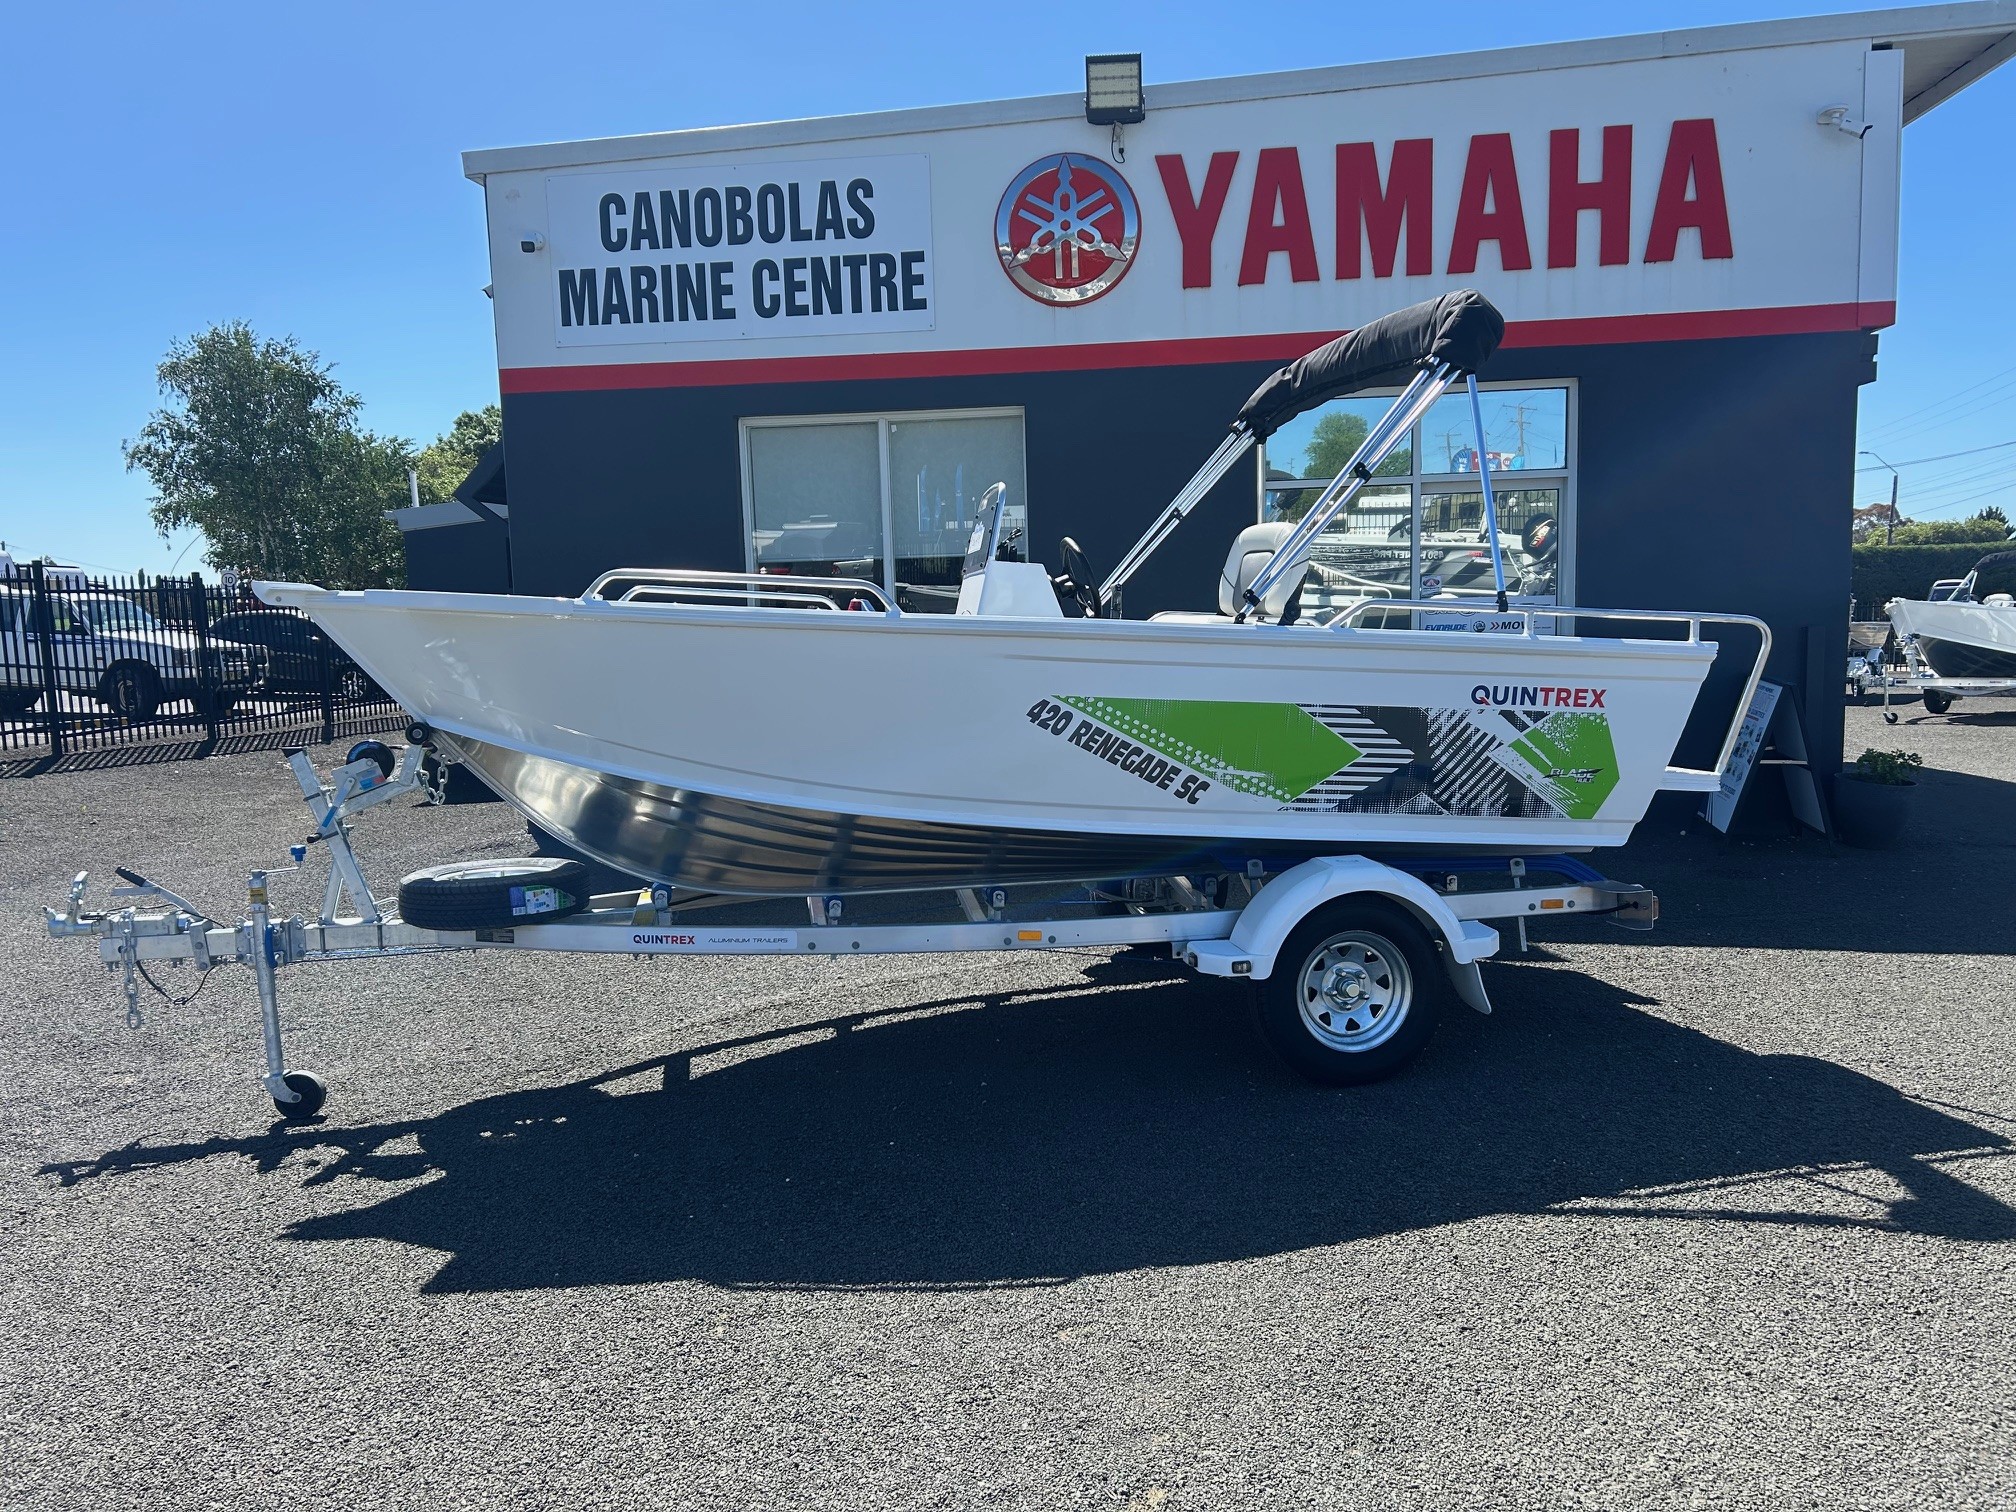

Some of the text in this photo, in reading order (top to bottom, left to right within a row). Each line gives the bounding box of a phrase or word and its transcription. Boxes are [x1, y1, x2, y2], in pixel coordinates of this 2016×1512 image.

[599, 178, 875, 253] CANOBOLAS
[1154, 118, 1733, 290] YAMAHA
[558, 250, 928, 327] MARINE CENTRE
[224, 576, 234, 584] 10
[1425, 623, 1468, 631] EVINRUDE
[1471, 685, 1607, 708] QUINTREX
[1026, 699, 1211, 805] 420 RENEGADE SC
[1549, 768, 1598, 778] BLADE
[633, 934, 696, 945] QUINTREX
